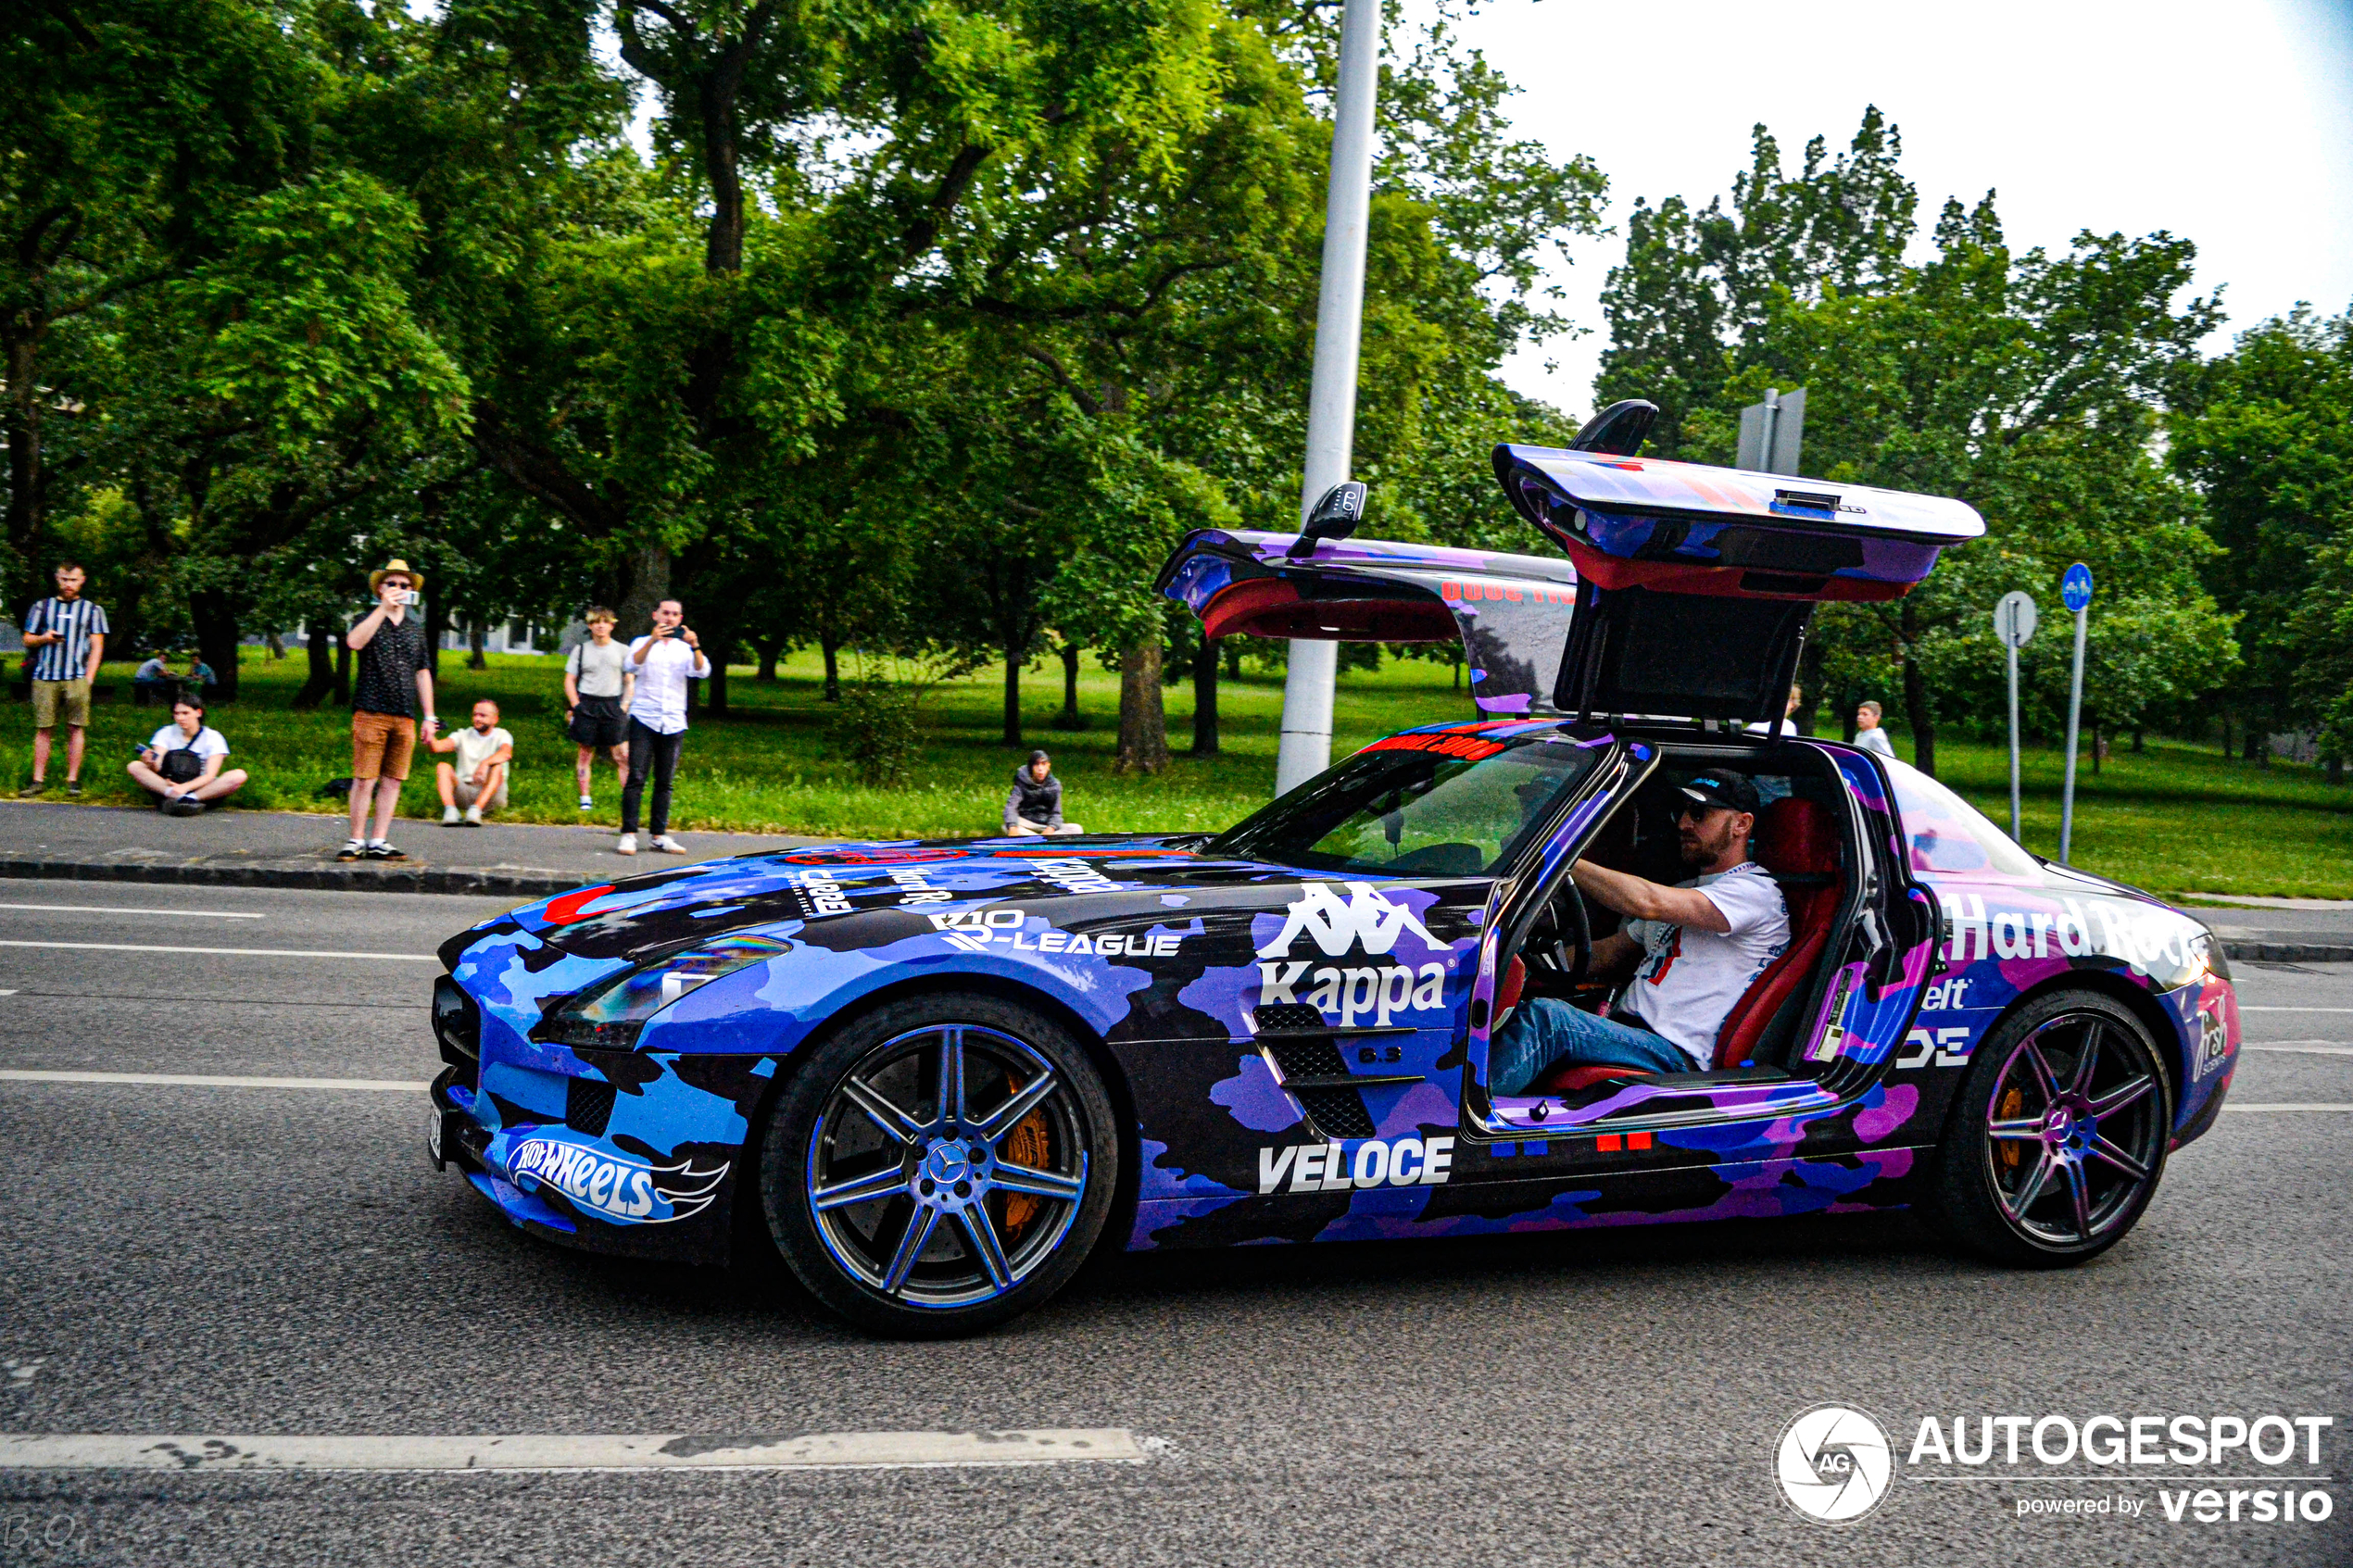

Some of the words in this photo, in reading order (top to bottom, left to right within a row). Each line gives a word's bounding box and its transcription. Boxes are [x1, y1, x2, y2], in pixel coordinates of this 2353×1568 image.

[1441, 581, 1524, 602] 3000
[1428, 735, 1505, 760] 3000
[799, 870, 853, 914] CARRE
[1941, 893, 2092, 960] Hard
[1256, 960, 1447, 1027] Kappa
[1358, 1046, 1402, 1063] 6.3
[1259, 1136, 1454, 1195] VELOCE
